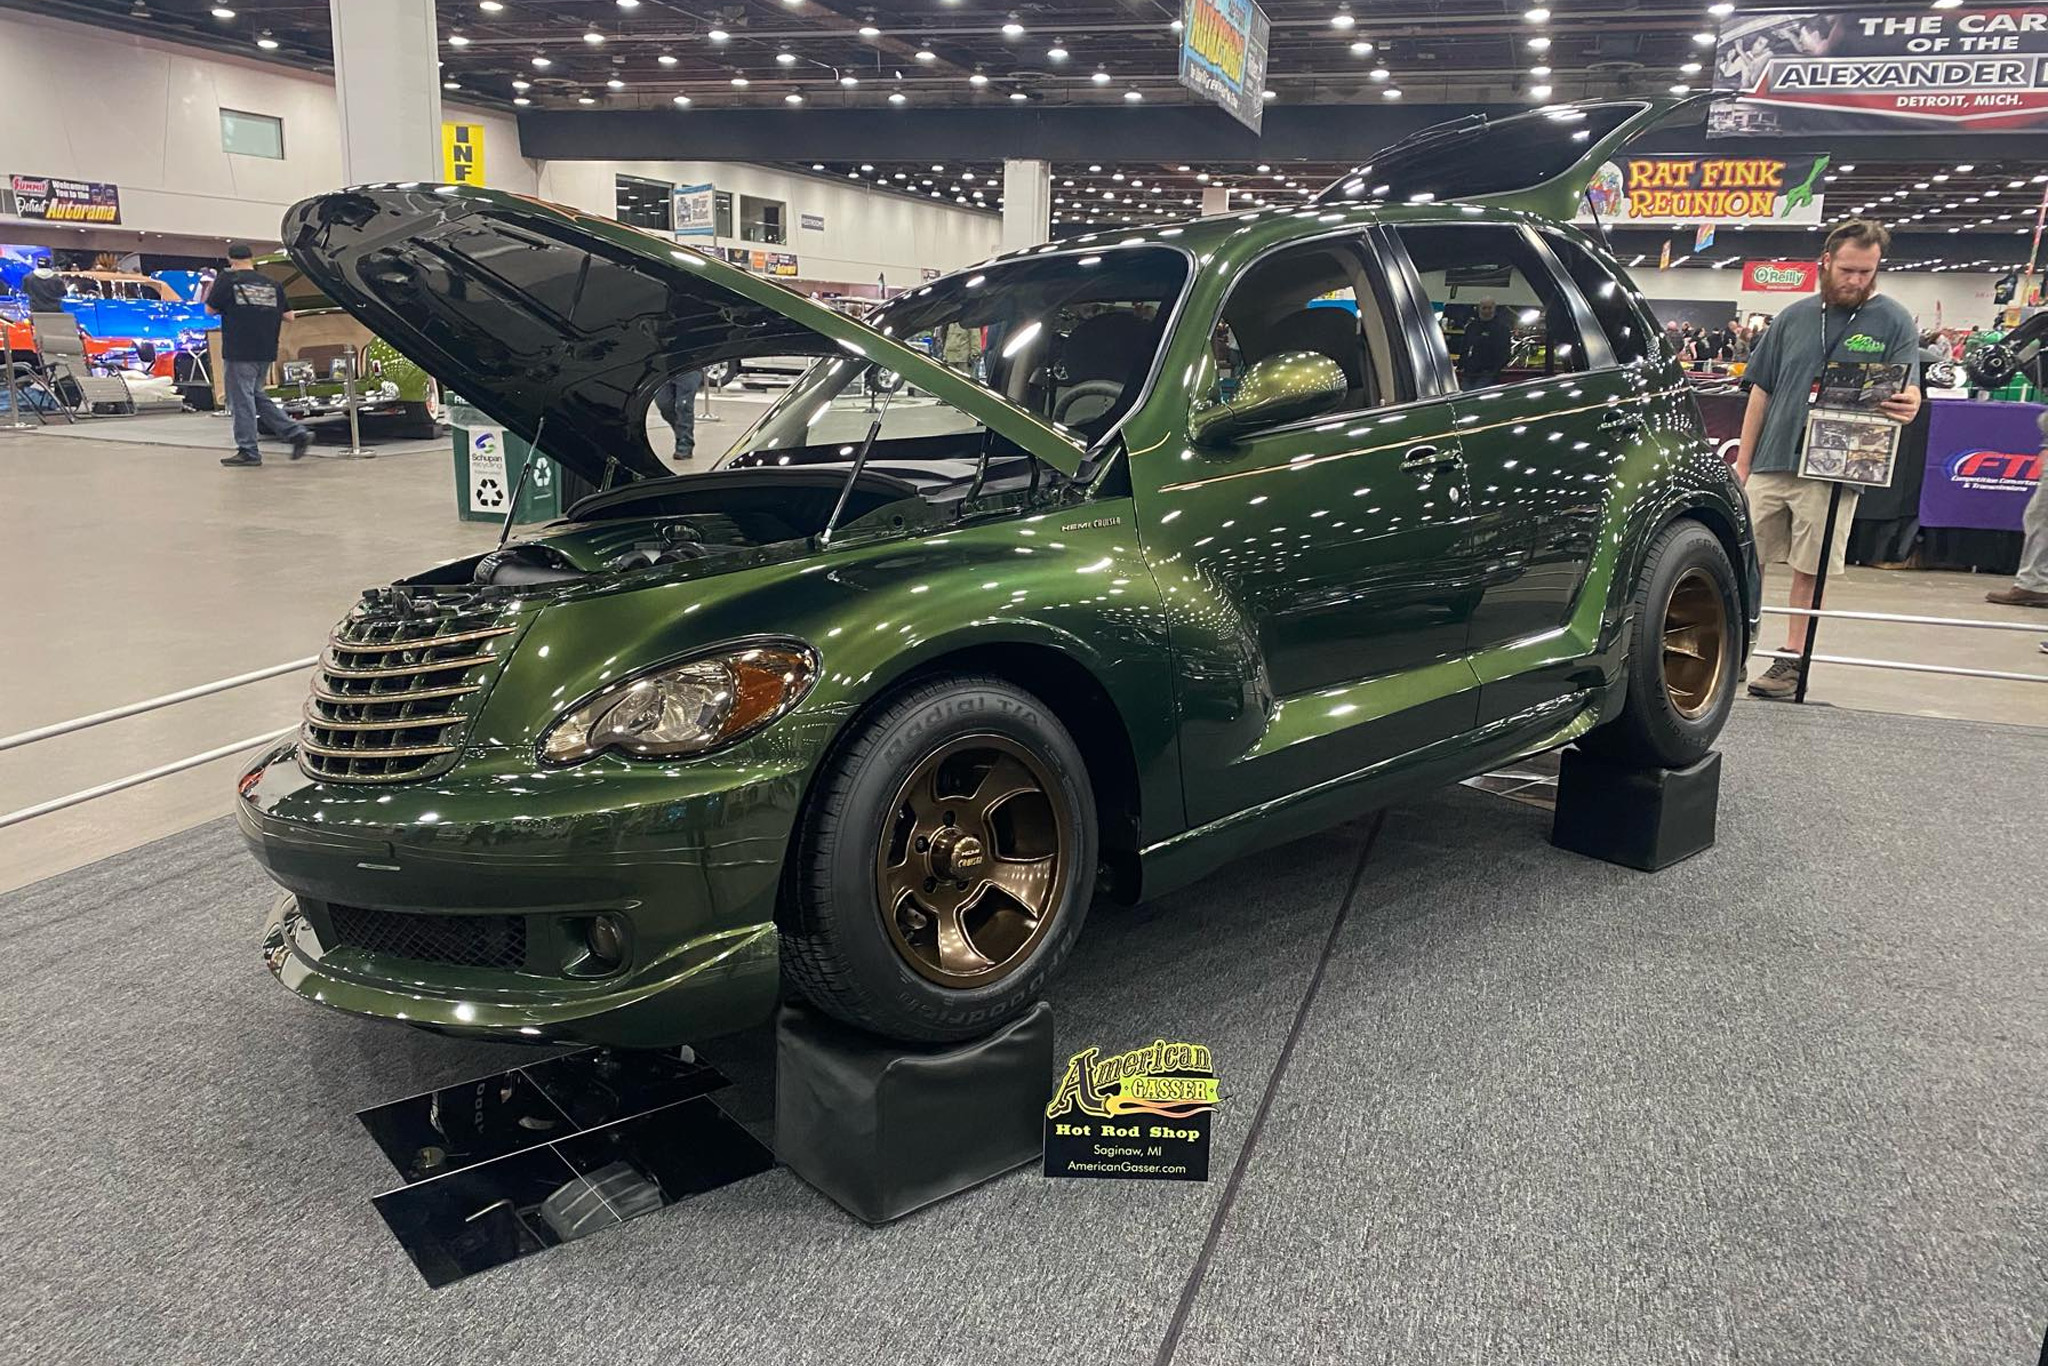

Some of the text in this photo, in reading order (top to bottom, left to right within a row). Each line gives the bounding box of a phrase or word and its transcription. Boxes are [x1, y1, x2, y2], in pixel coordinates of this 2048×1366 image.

[1859, 16, 1943, 36] THE
[1907, 35, 2019, 52] OF THE
[1776, 59, 2028, 89] ALEXANDER
[1896, 94, 2024, 108] DETROIT, MICH.
[453, 125, 473, 184] INF
[1628, 159, 1787, 189] RAT FINK
[55, 188, 69, 198] You
[16, 196, 117, 221] Detroit Autorama
[1628, 189, 1777, 219] REUNION
[471, 452, 503, 463] Schupan
[1061, 522, 1092, 532] HEMI
[1047, 1041, 1213, 1118] American
[1132, 1077, 1208, 1101] GASSER
[1055, 1123, 1201, 1142] Hot Rod Shop
[1093, 1144, 1163, 1159] Saginaw, MI
[1067, 1160, 1187, 1174] AmericanGasser.com
